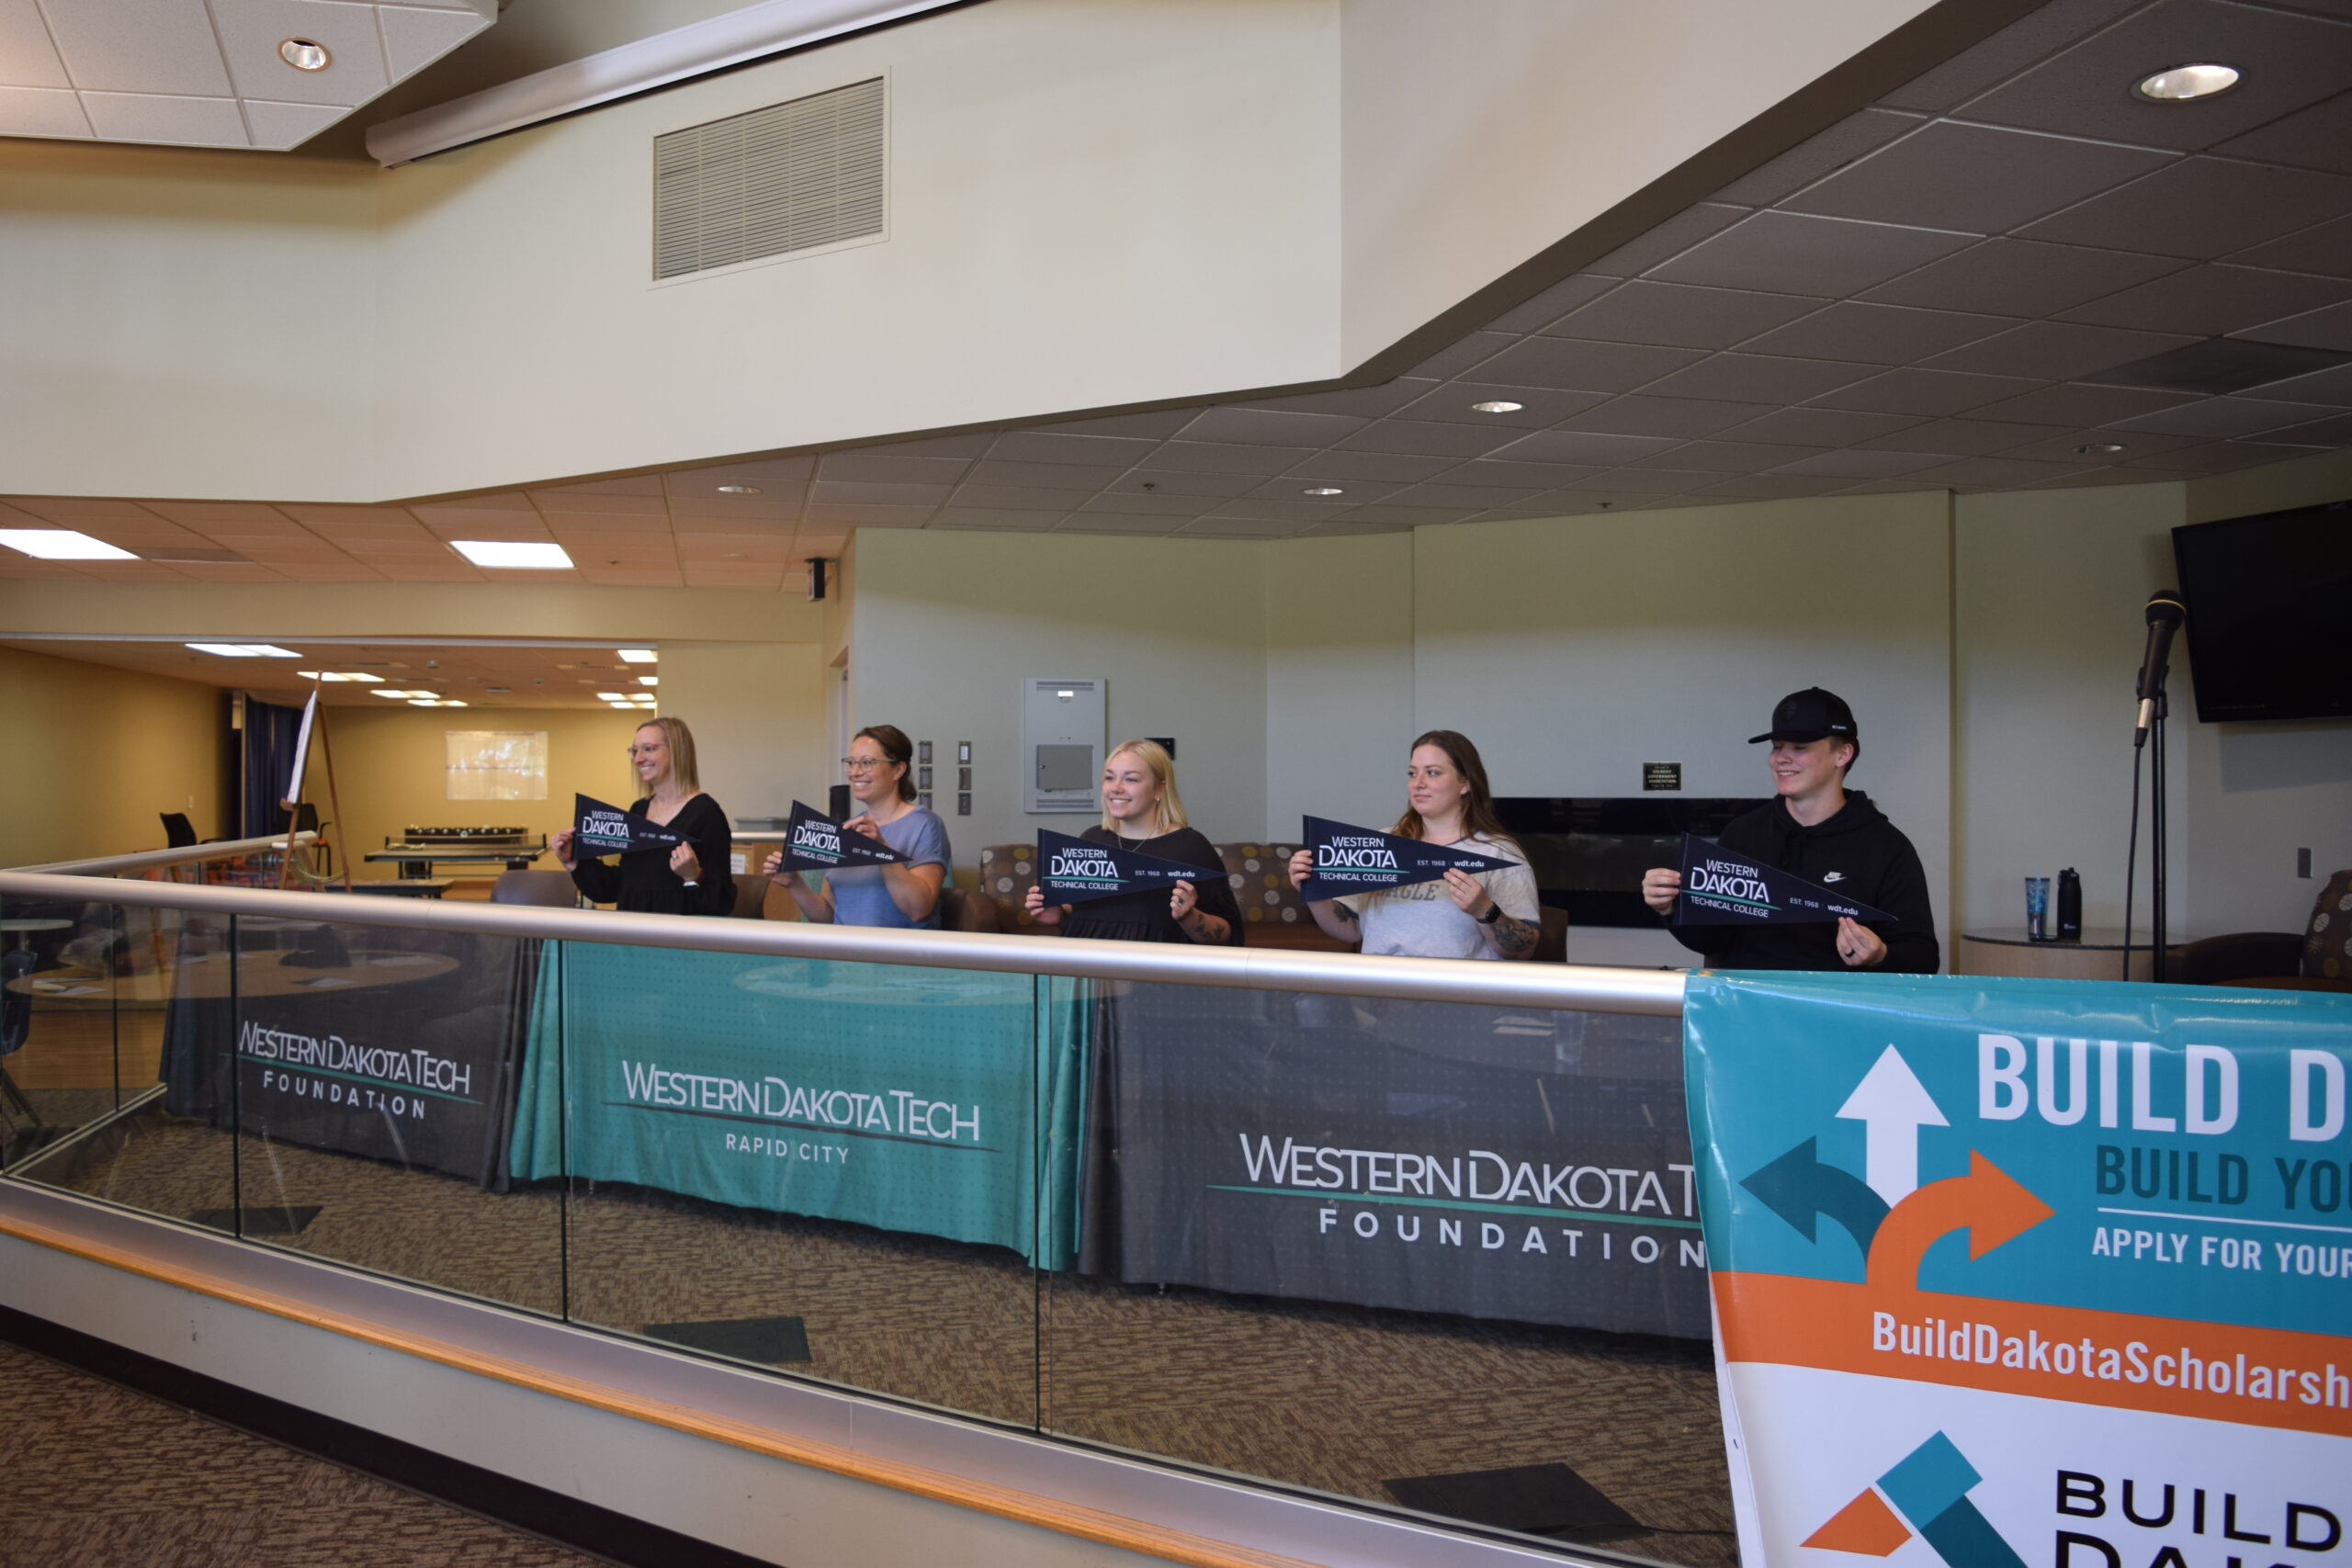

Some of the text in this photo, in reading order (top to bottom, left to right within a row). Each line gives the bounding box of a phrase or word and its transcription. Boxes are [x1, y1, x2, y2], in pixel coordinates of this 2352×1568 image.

[592, 810, 624, 821] WESTERN
[805, 819, 836, 833] WESTERN
[582, 817, 629, 838] DAKOTA
[582, 837, 628, 849] TECHNICAL COLLEGE
[794, 826, 841, 852] DAKOTA
[1332, 836, 1385, 848] WESTERN
[792, 848, 839, 864] TECHNICAL COLLEGE
[1062, 847, 1107, 858] WESTERN
[1319, 845, 1397, 868] DAKOTA
[1051, 856, 1118, 878] DAKOTA
[1454, 860, 1485, 868] wdt.edu
[1706, 859, 1758, 878] WESTERN
[1051, 880, 1119, 891] TECHNICAL COLLEGE
[1319, 873, 1397, 883] TECHNICAL COLLEGE
[1690, 867, 1770, 903] DAKOTA
[1690, 896, 1770, 918] TECHNICAL COLLEGE
[1804, 899, 1819, 908] 1968
[1827, 903, 1859, 916] wdt.edu
[264, 1070, 424, 1119] FOUNDATION
[1978, 1033, 2239, 1135] BUILD
[726, 1134, 849, 1164] RAPID CITY
[2096, 1145, 2352, 1213] BUILD YO
[1319, 1208, 1705, 1269] FOUNDATION
[2092, 1226, 2189, 1263] APPLY
[2201, 1235, 2262, 1270] FOR
[1873, 1311, 2349, 1409] BuildDakotaScholarsh
[2056, 1470, 2341, 1552] BUILD
